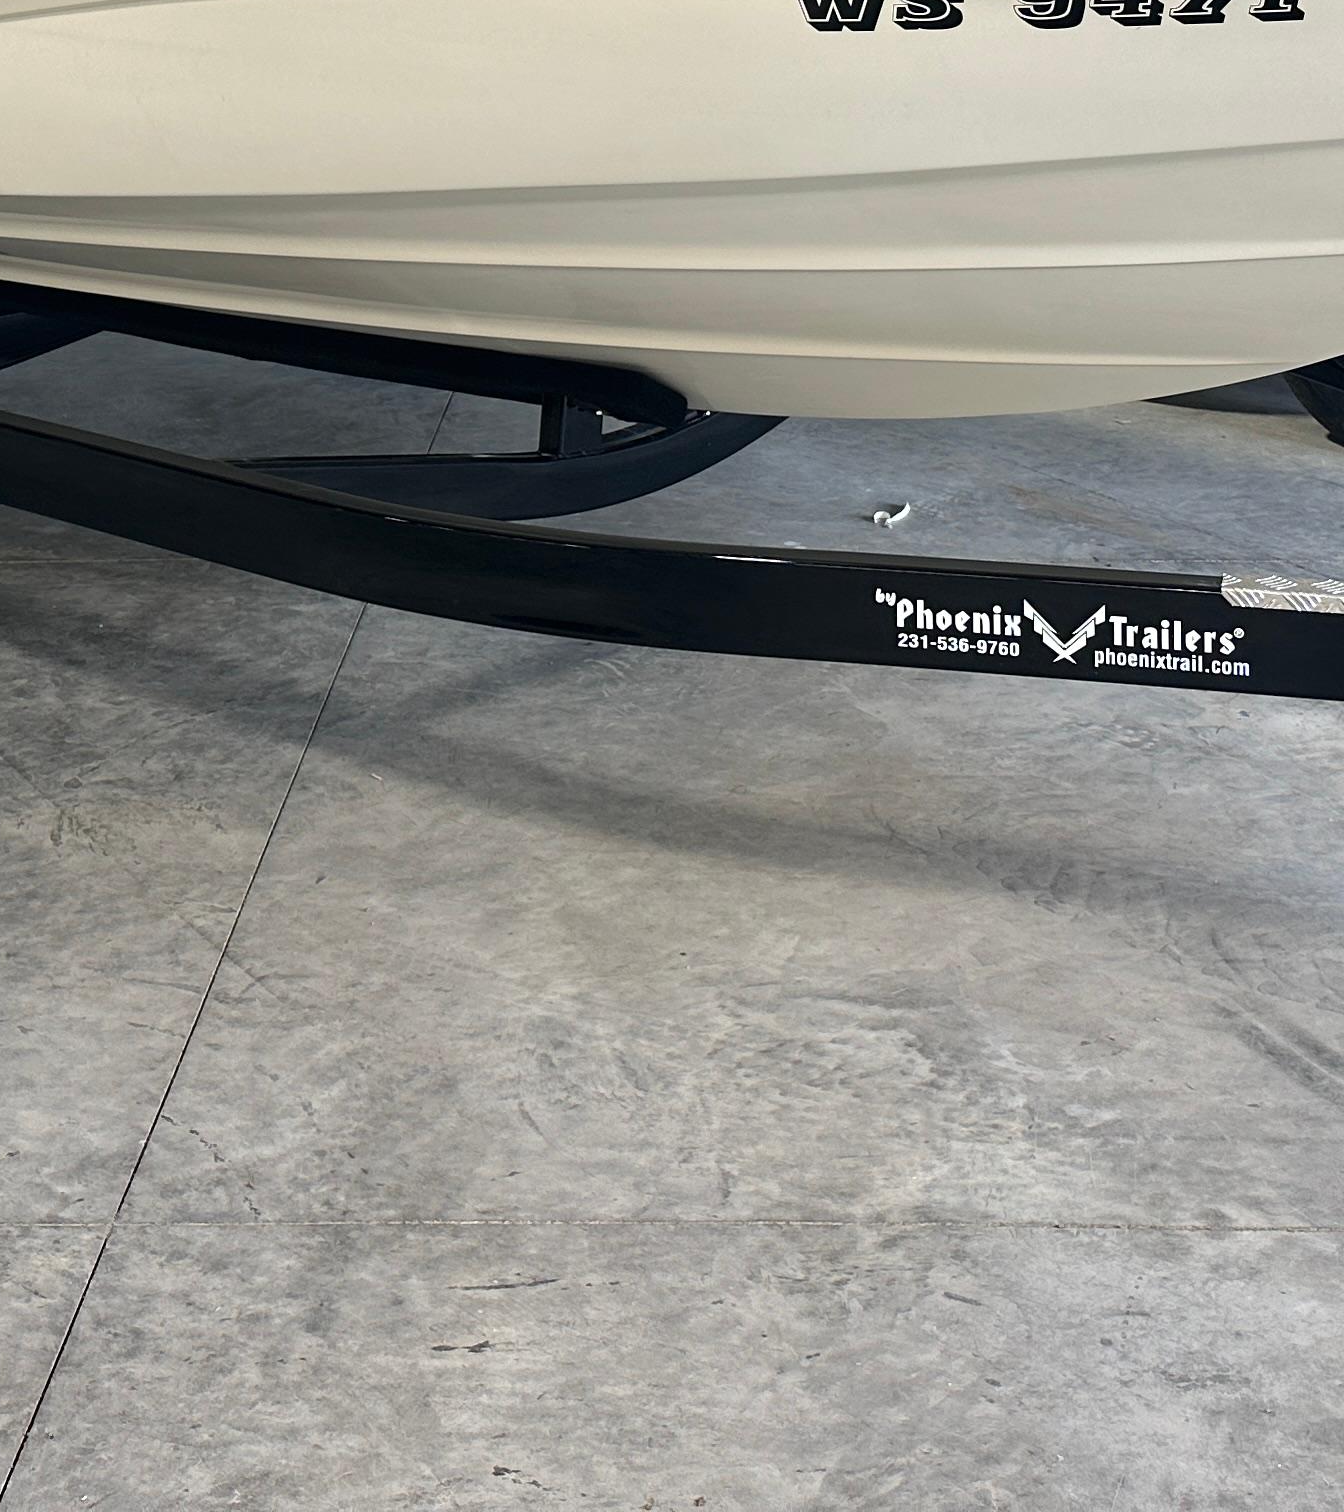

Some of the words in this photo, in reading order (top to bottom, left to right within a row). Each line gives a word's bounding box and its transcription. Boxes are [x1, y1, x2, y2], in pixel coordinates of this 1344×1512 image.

[875, 587, 897, 607] by
[896, 597, 1022, 637] Phoenix
[897, 632, 1020, 657] 231-536-9760
[1094, 647, 1251, 677] phoenixtrail.com
